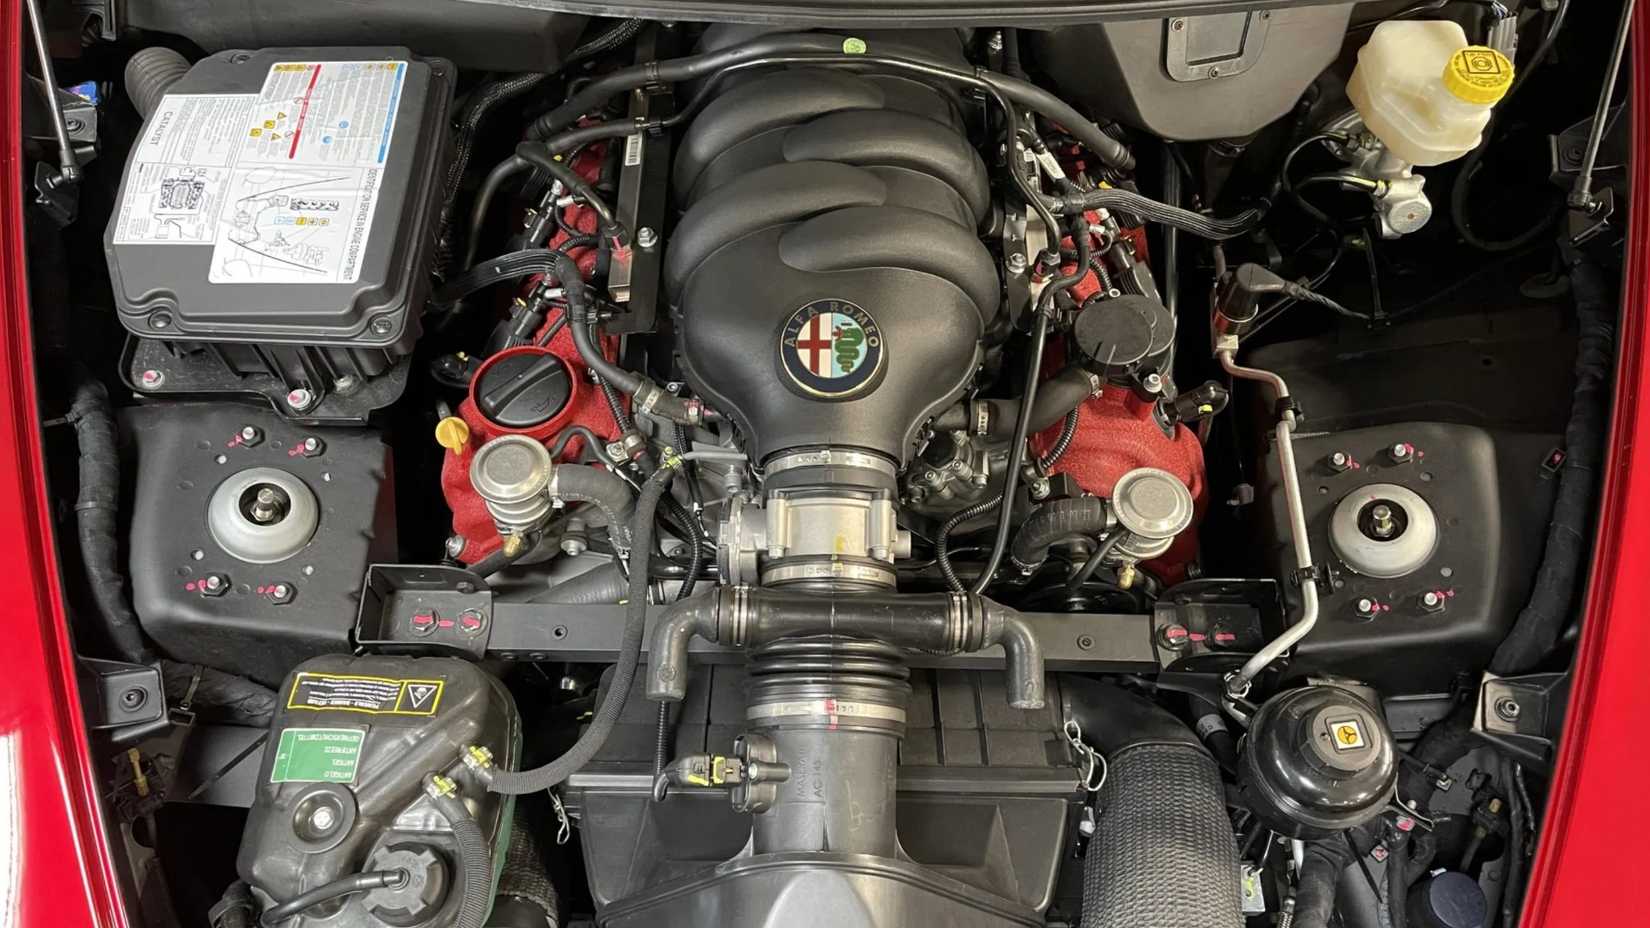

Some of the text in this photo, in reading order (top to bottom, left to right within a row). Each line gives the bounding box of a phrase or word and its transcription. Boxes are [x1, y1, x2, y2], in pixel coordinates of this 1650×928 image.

[149, 111, 173, 145] CATALYST
[784, 302, 879, 348] ALFA ROMEO
